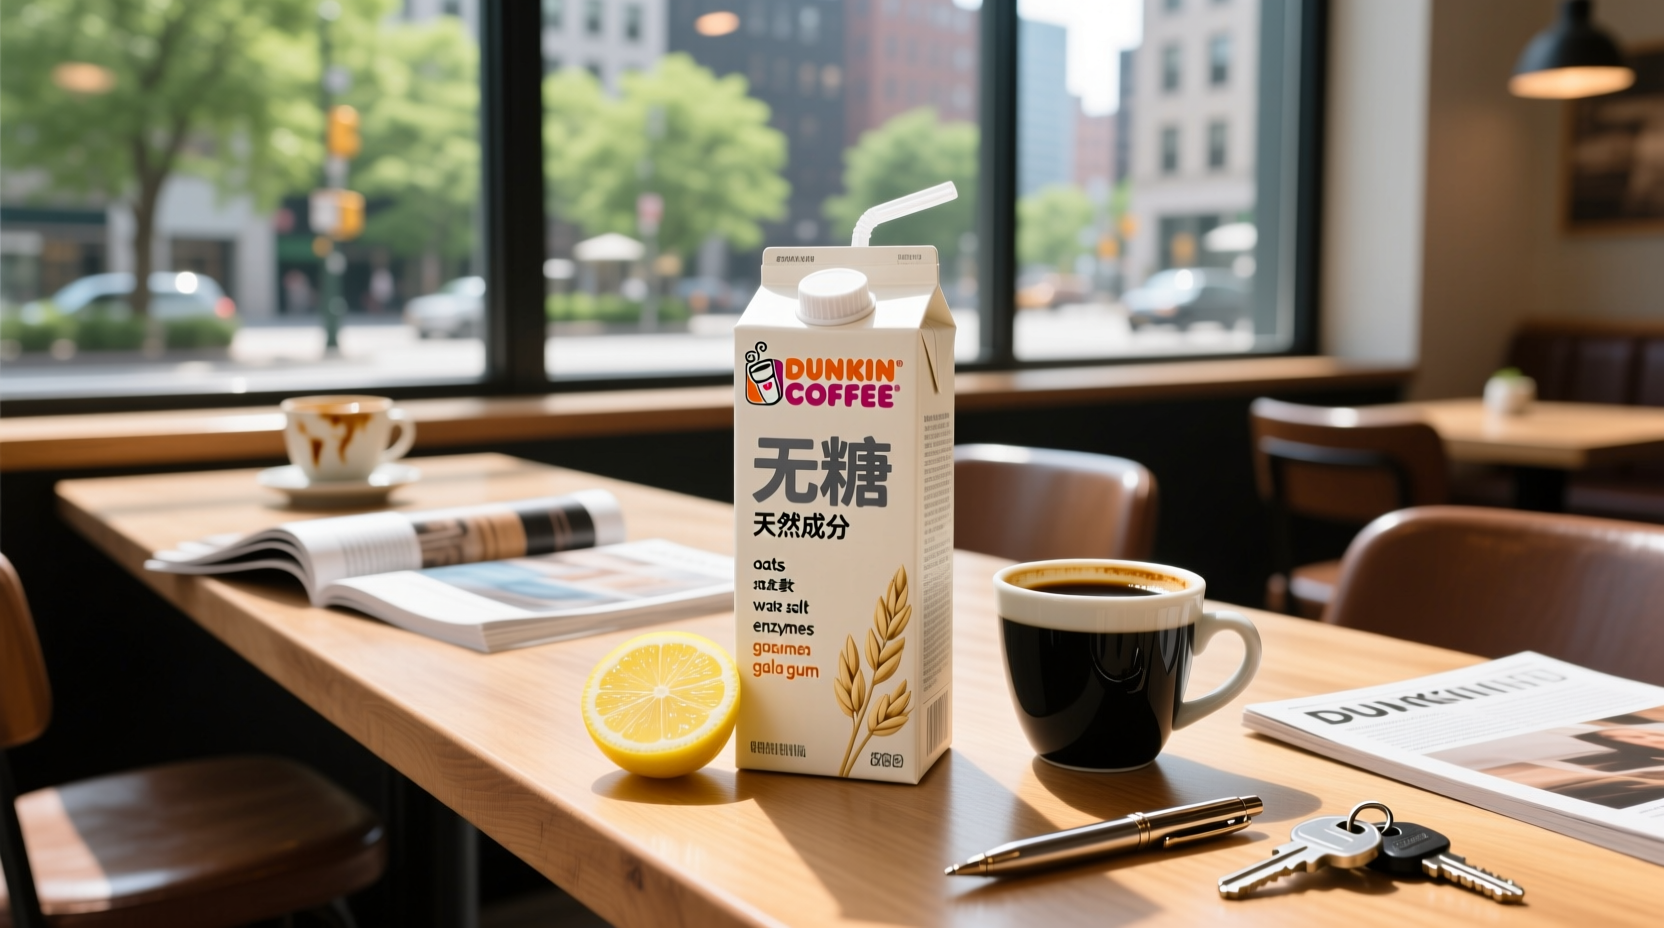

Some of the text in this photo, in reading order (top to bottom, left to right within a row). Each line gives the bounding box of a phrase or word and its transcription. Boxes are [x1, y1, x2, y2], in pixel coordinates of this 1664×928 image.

[785, 358, 895, 382] DUNKIN
[785, 383, 894, 408] COFFEE
[752, 436, 892, 507] 无糖
[753, 511, 850, 540] 天然成分
[753, 557, 786, 572] oats
[753, 621, 815, 637] enzymes
[786, 665, 819, 680] gum
